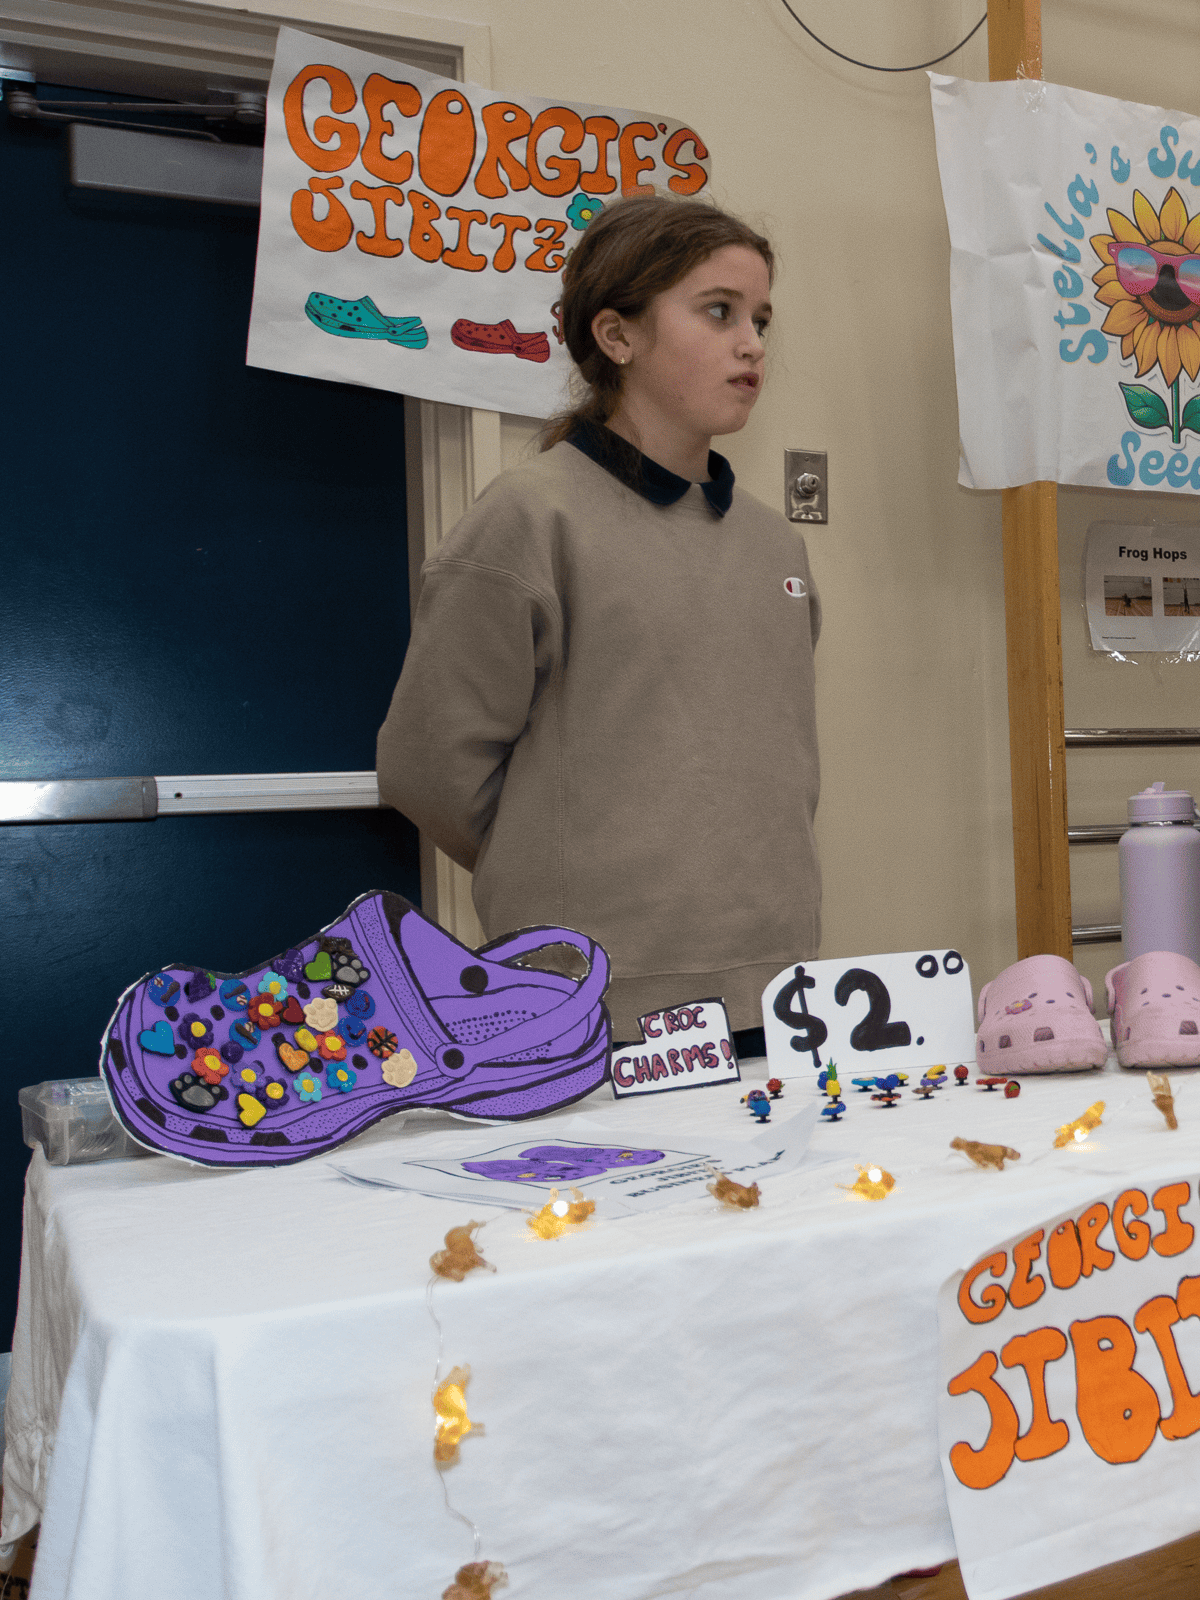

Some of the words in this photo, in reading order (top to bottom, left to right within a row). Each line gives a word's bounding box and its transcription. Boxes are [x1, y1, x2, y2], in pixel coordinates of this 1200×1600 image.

[283, 64, 709, 200] GEORGIE'S
[290, 175, 568, 272] JIBITZ
[1036, 142, 1131, 364] Stella's
[1118, 546, 1149, 561] Frog
[1153, 547, 1188, 562] Hops
[643, 1006, 708, 1038] CROC
[614, 1038, 735, 1087] CHARMS!
